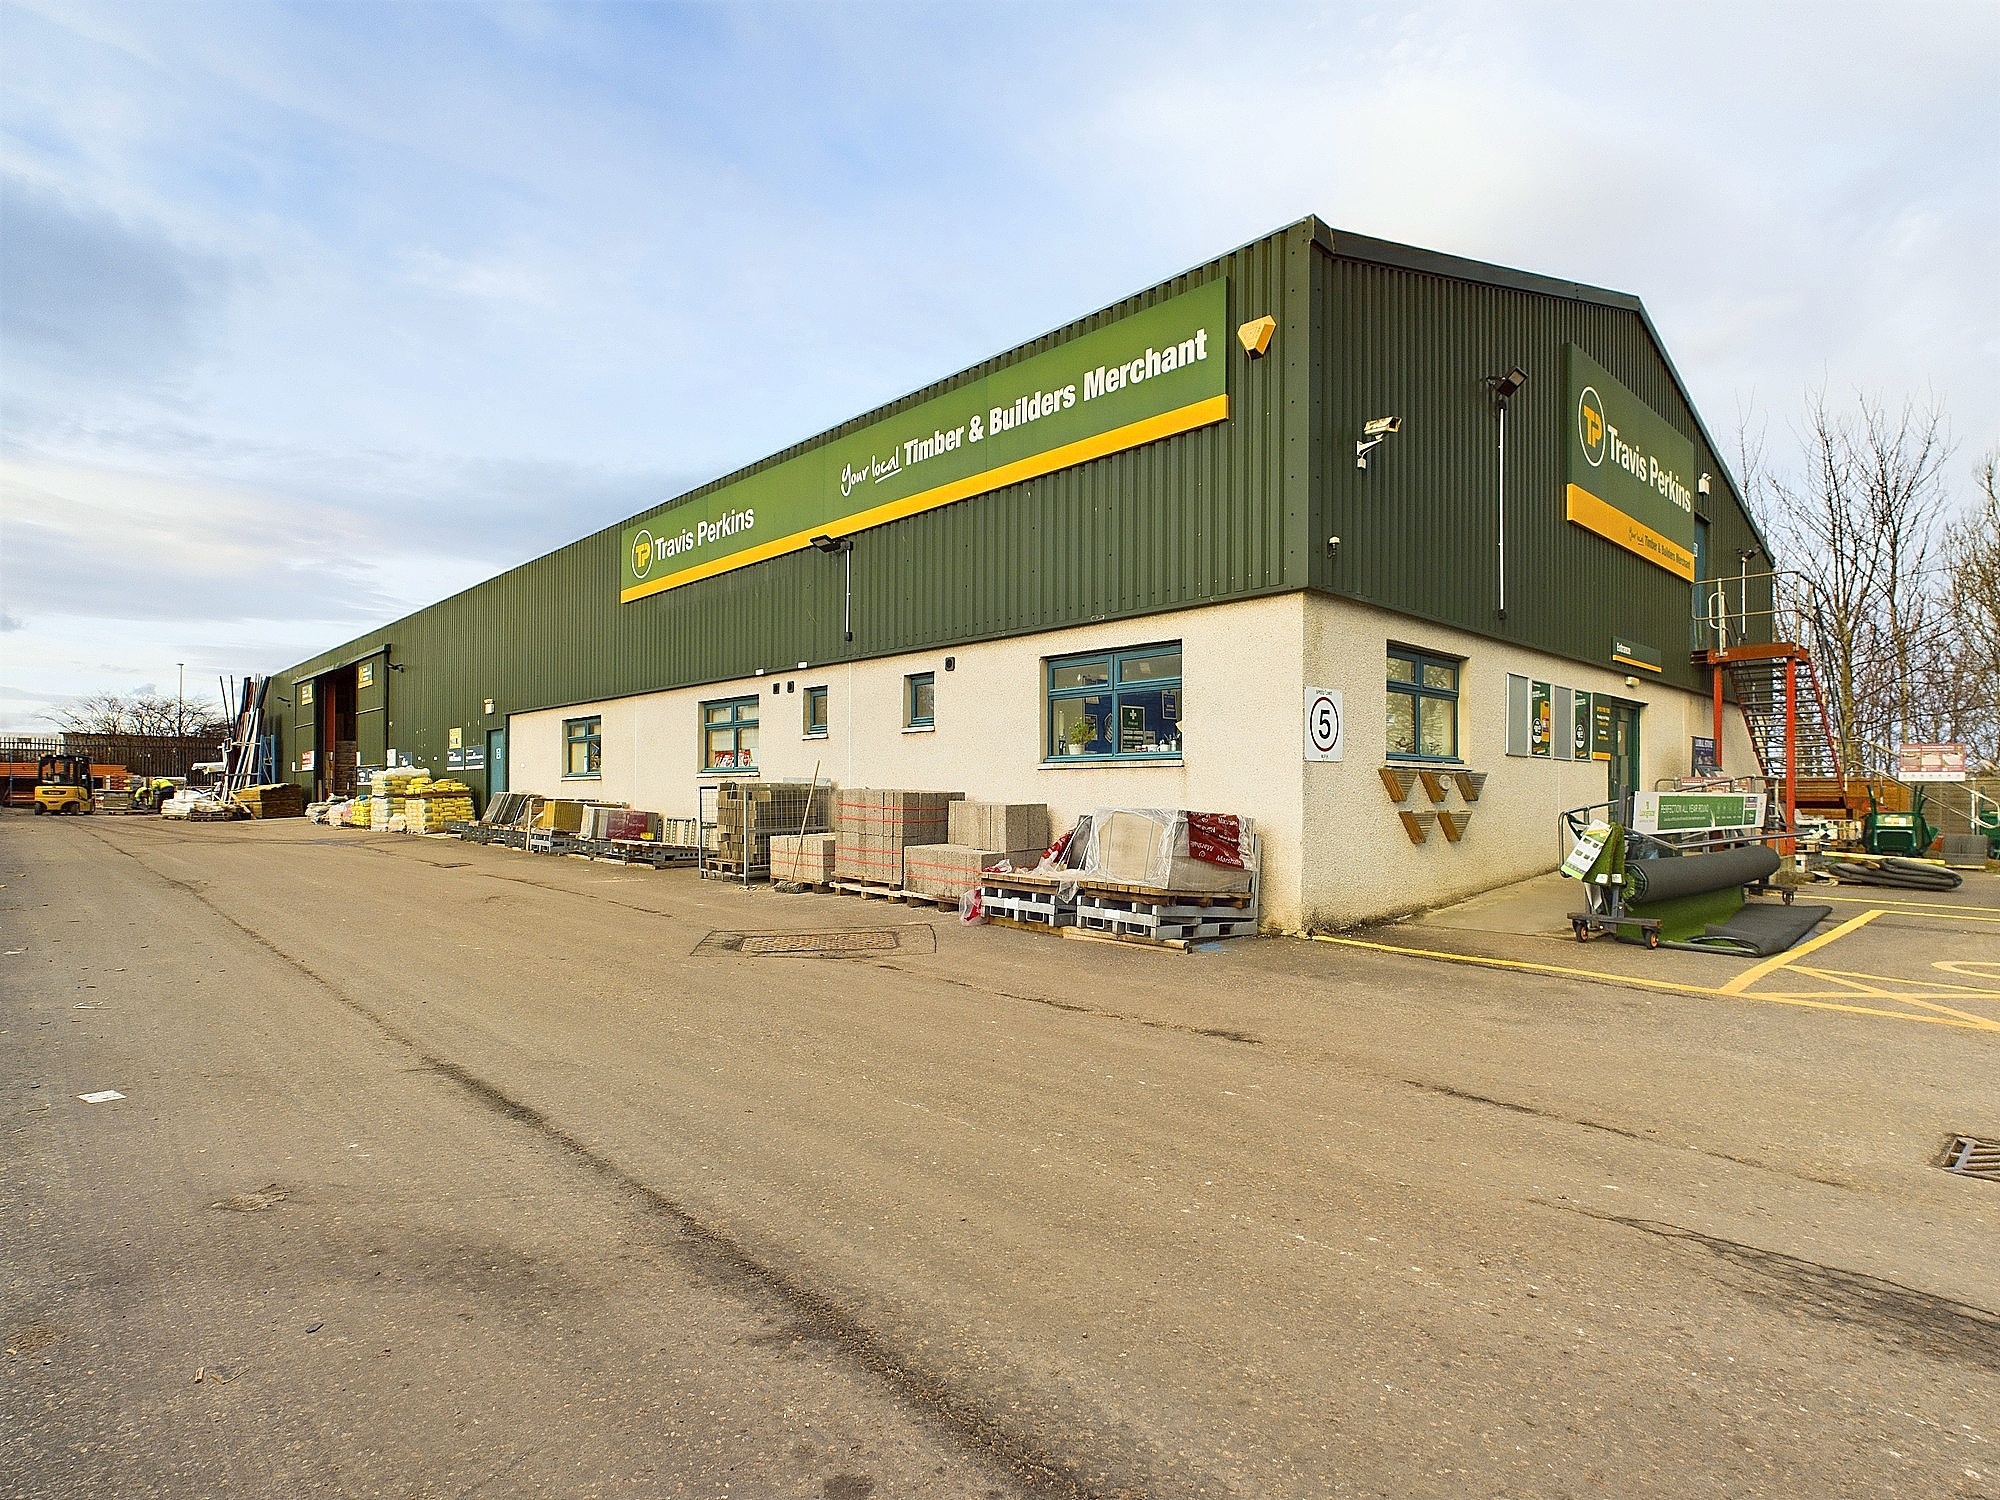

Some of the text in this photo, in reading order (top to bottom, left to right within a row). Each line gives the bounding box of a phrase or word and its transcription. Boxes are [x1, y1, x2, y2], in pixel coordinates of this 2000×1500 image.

[841, 328, 1208, 496] Your local Timber & Builders Merchant
[1607, 424, 1692, 513] Travis Perkins
[654, 507, 755, 561] Travis Perkins
[1318, 708, 1331, 740] 5
